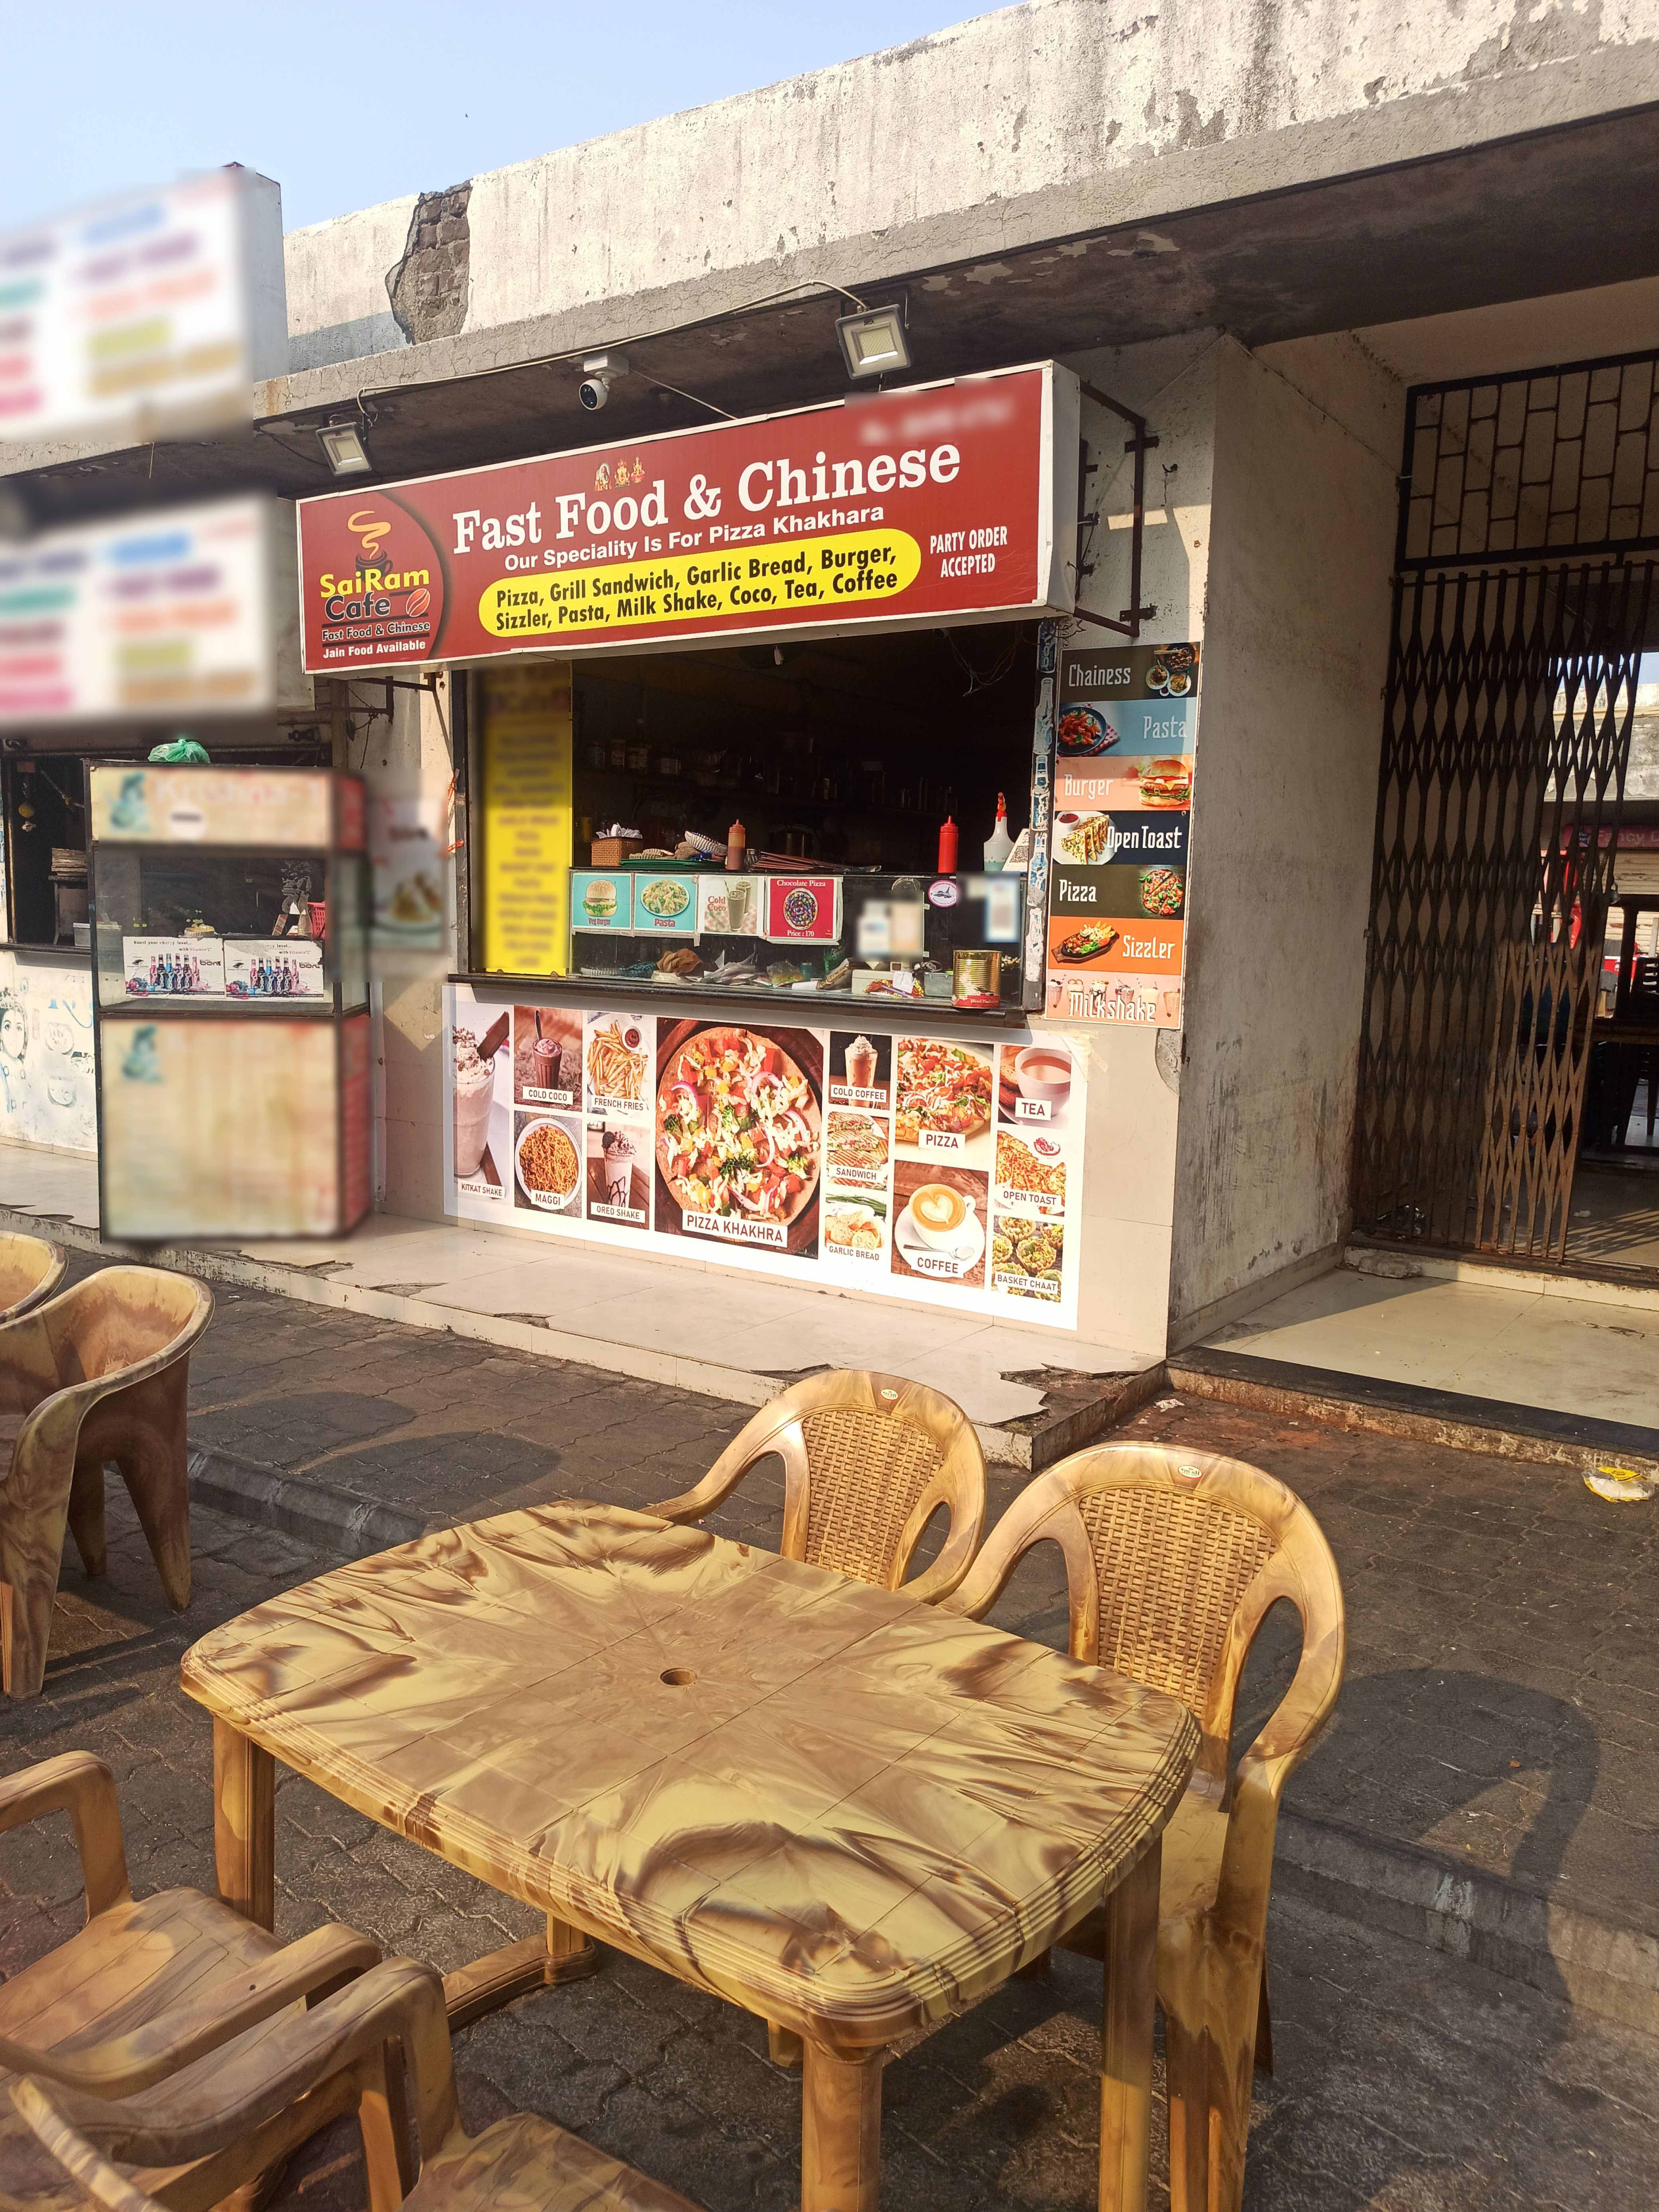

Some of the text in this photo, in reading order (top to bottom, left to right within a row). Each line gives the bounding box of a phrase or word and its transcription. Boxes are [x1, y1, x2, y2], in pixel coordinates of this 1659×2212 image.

[453, 444, 960, 554] Fast Food & Chinese
[505, 506, 884, 571] Our Speciality Is For Pizza Khakhara
[930, 526, 1007, 555] PARTY ORDER
[941, 553, 995, 578] ACCEPTED
[320, 569, 430, 598] SaiRam
[497, 546, 896, 608] Pizza, Grill Sandwich, Garlic Bread, Burger,
[325, 591, 390, 622] Cafe
[496, 569, 897, 631] Sizzler, Pasta, Milk Shake, Coco, Tea, Coffee
[322, 622, 430, 641] Fast Food & Chinese
[323, 640, 425, 659] Jain Food Available
[1069, 664, 1131, 687] Chainess
[1143, 715, 1187, 739] Pasta
[1064, 774, 1113, 800] Burger
[1107, 826, 1182, 852] Open Toast
[1059, 879, 1097, 902] Pizza
[707, 903, 726, 912] Coco
[708, 896, 726, 905] Cold
[654, 918, 675, 927] Pasta
[1123, 935, 1176, 959] Sizzler
[1069, 991, 1156, 1022] Milkshake
[529, 1090, 567, 1102] COLD COCO
[833, 1087, 885, 1100] COLD COFFEE
[594, 1098, 644, 1111] FRENCH FRIES
[1021, 1102, 1045, 1116] TEA
[926, 1134, 958, 1149] PIZZA
[836, 1167, 877, 1180] SANDWICH
[461, 1183, 502, 1196] KITKAT SHAKE
[1004, 1191, 1057, 1206] OPEN TOAST
[535, 1194, 561, 1205] MAGGI
[596, 1205, 640, 1220] OREO SHAKE
[687, 1215, 783, 1243] PIZZA KHAKHRA
[829, 1246, 880, 1261] GARLIC BREAD
[917, 1257, 958, 1274] COFFEE
[997, 1275, 1057, 1291] BASKET CHAAT
